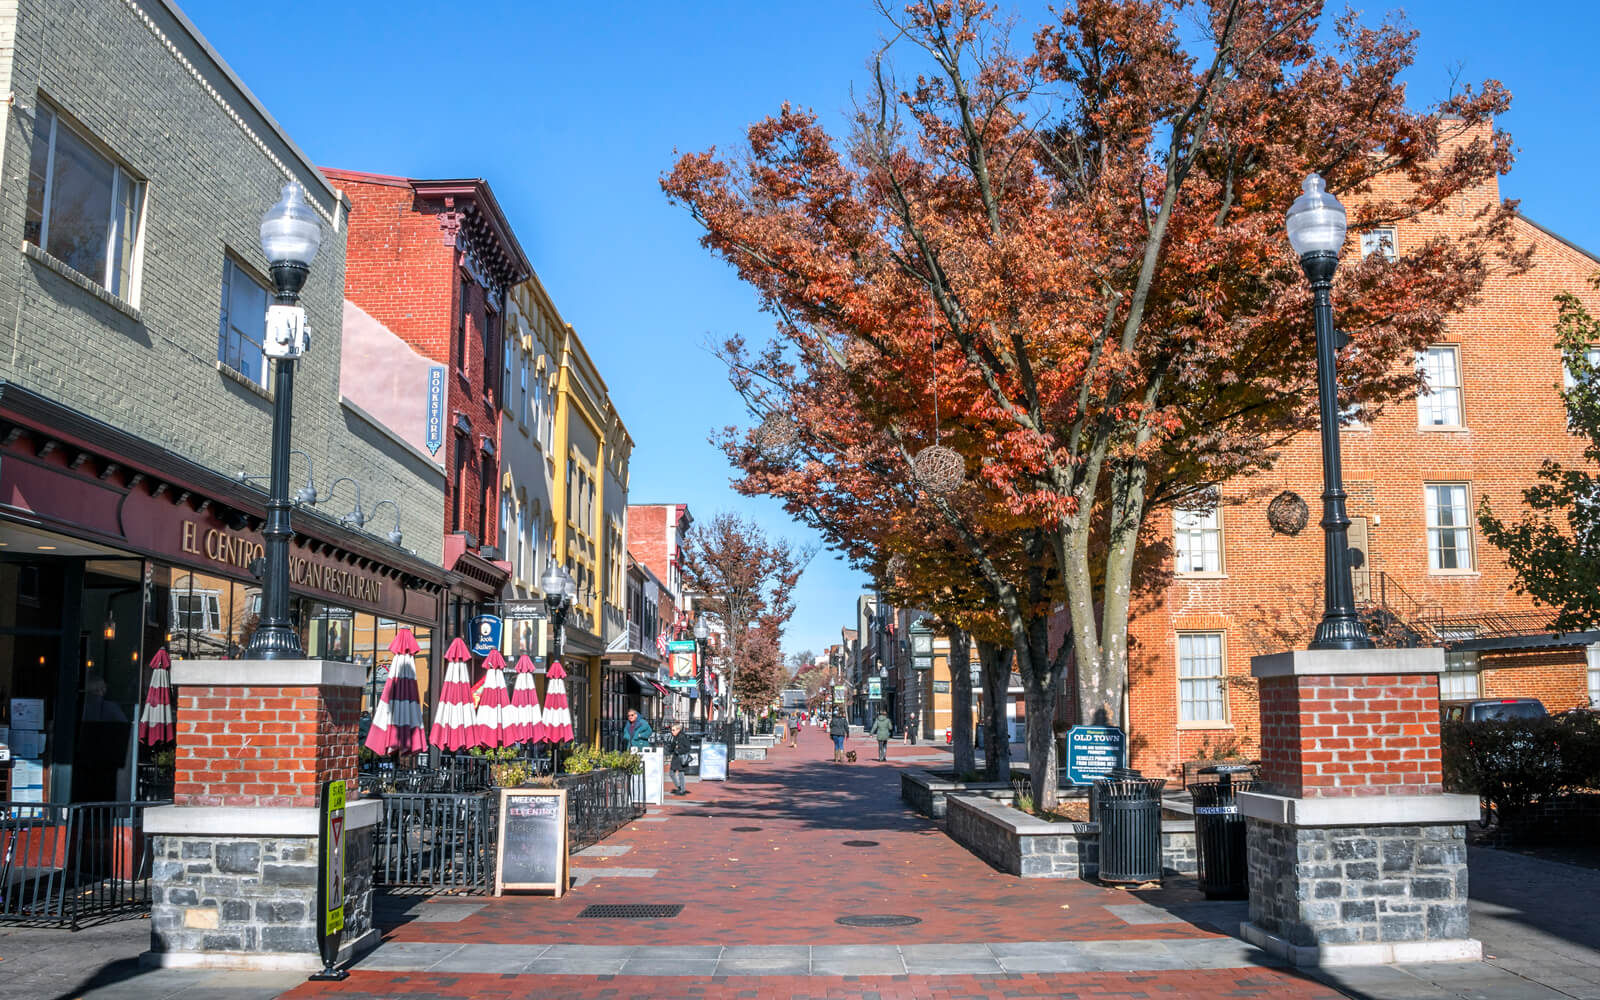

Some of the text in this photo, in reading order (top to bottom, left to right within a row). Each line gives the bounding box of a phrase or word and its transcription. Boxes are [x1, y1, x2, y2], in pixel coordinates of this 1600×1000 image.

[430, 371, 441, 440] BOOKSTORE
[182, 519, 200, 555] EL
[288, 554, 324, 590] XICAN
[323, 565, 383, 603] RESTAURANT
[1073, 734, 1120, 742] OLD TOWN
[333, 784, 344, 796] STATE
[511, 796, 555, 804] WELCOME
